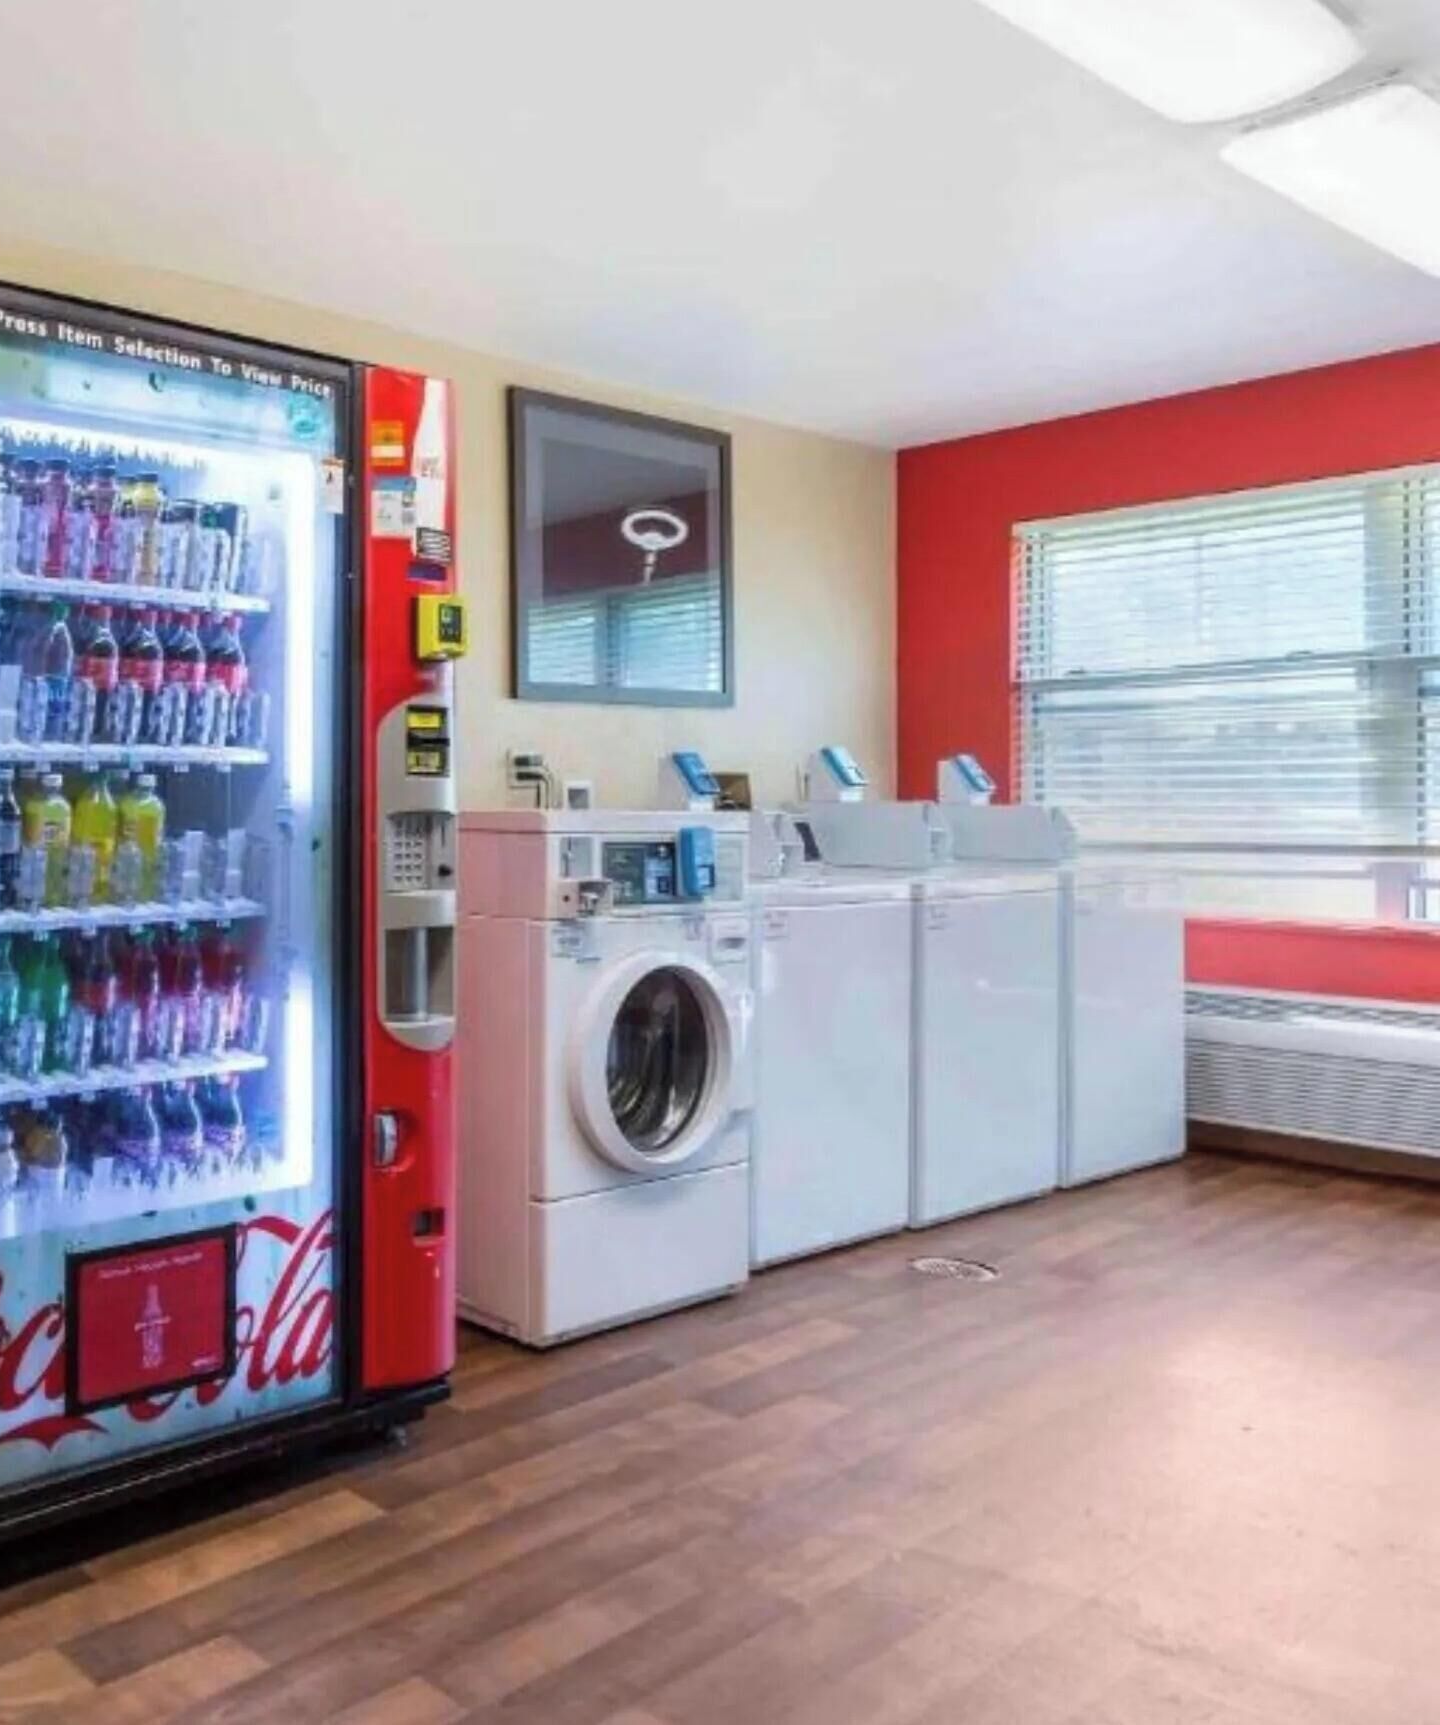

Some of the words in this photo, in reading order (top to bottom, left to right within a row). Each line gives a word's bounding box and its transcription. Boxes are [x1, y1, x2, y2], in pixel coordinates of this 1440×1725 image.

[58, 323, 103, 350] Item
[114, 336, 202, 370] Selection
[211, 355, 233, 377] To
[241, 361, 283, 386] View
[291, 374, 332, 398] Price
